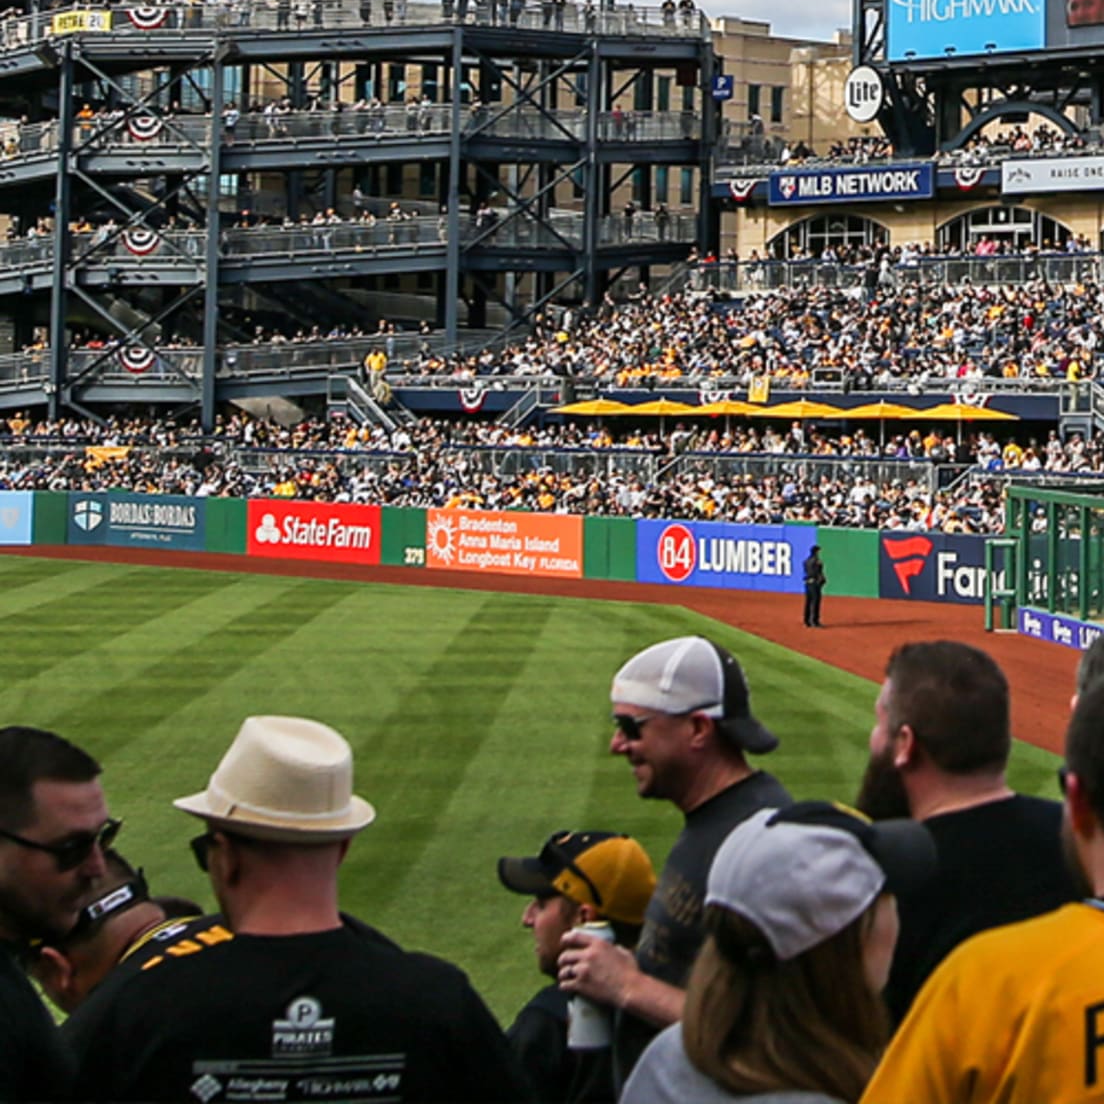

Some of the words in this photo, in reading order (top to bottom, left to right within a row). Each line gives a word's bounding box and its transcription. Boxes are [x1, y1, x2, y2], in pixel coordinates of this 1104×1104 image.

[848, 81, 880, 108] Lite
[798, 175, 833, 197] MLB
[836, 169, 920, 195] NETWORK
[1050, 167, 1079, 178] RAISE
[1084, 165, 1104, 178] ONE
[459, 515, 518, 533] Bradenton
[459, 533, 487, 548] Anna
[490, 534, 522, 551] Maria
[525, 536, 560, 553] Island
[458, 549, 511, 569] Longboat
[514, 552, 537, 572] Key
[663, 536, 691, 570] 84
[698, 537, 792, 576] LUMBER
